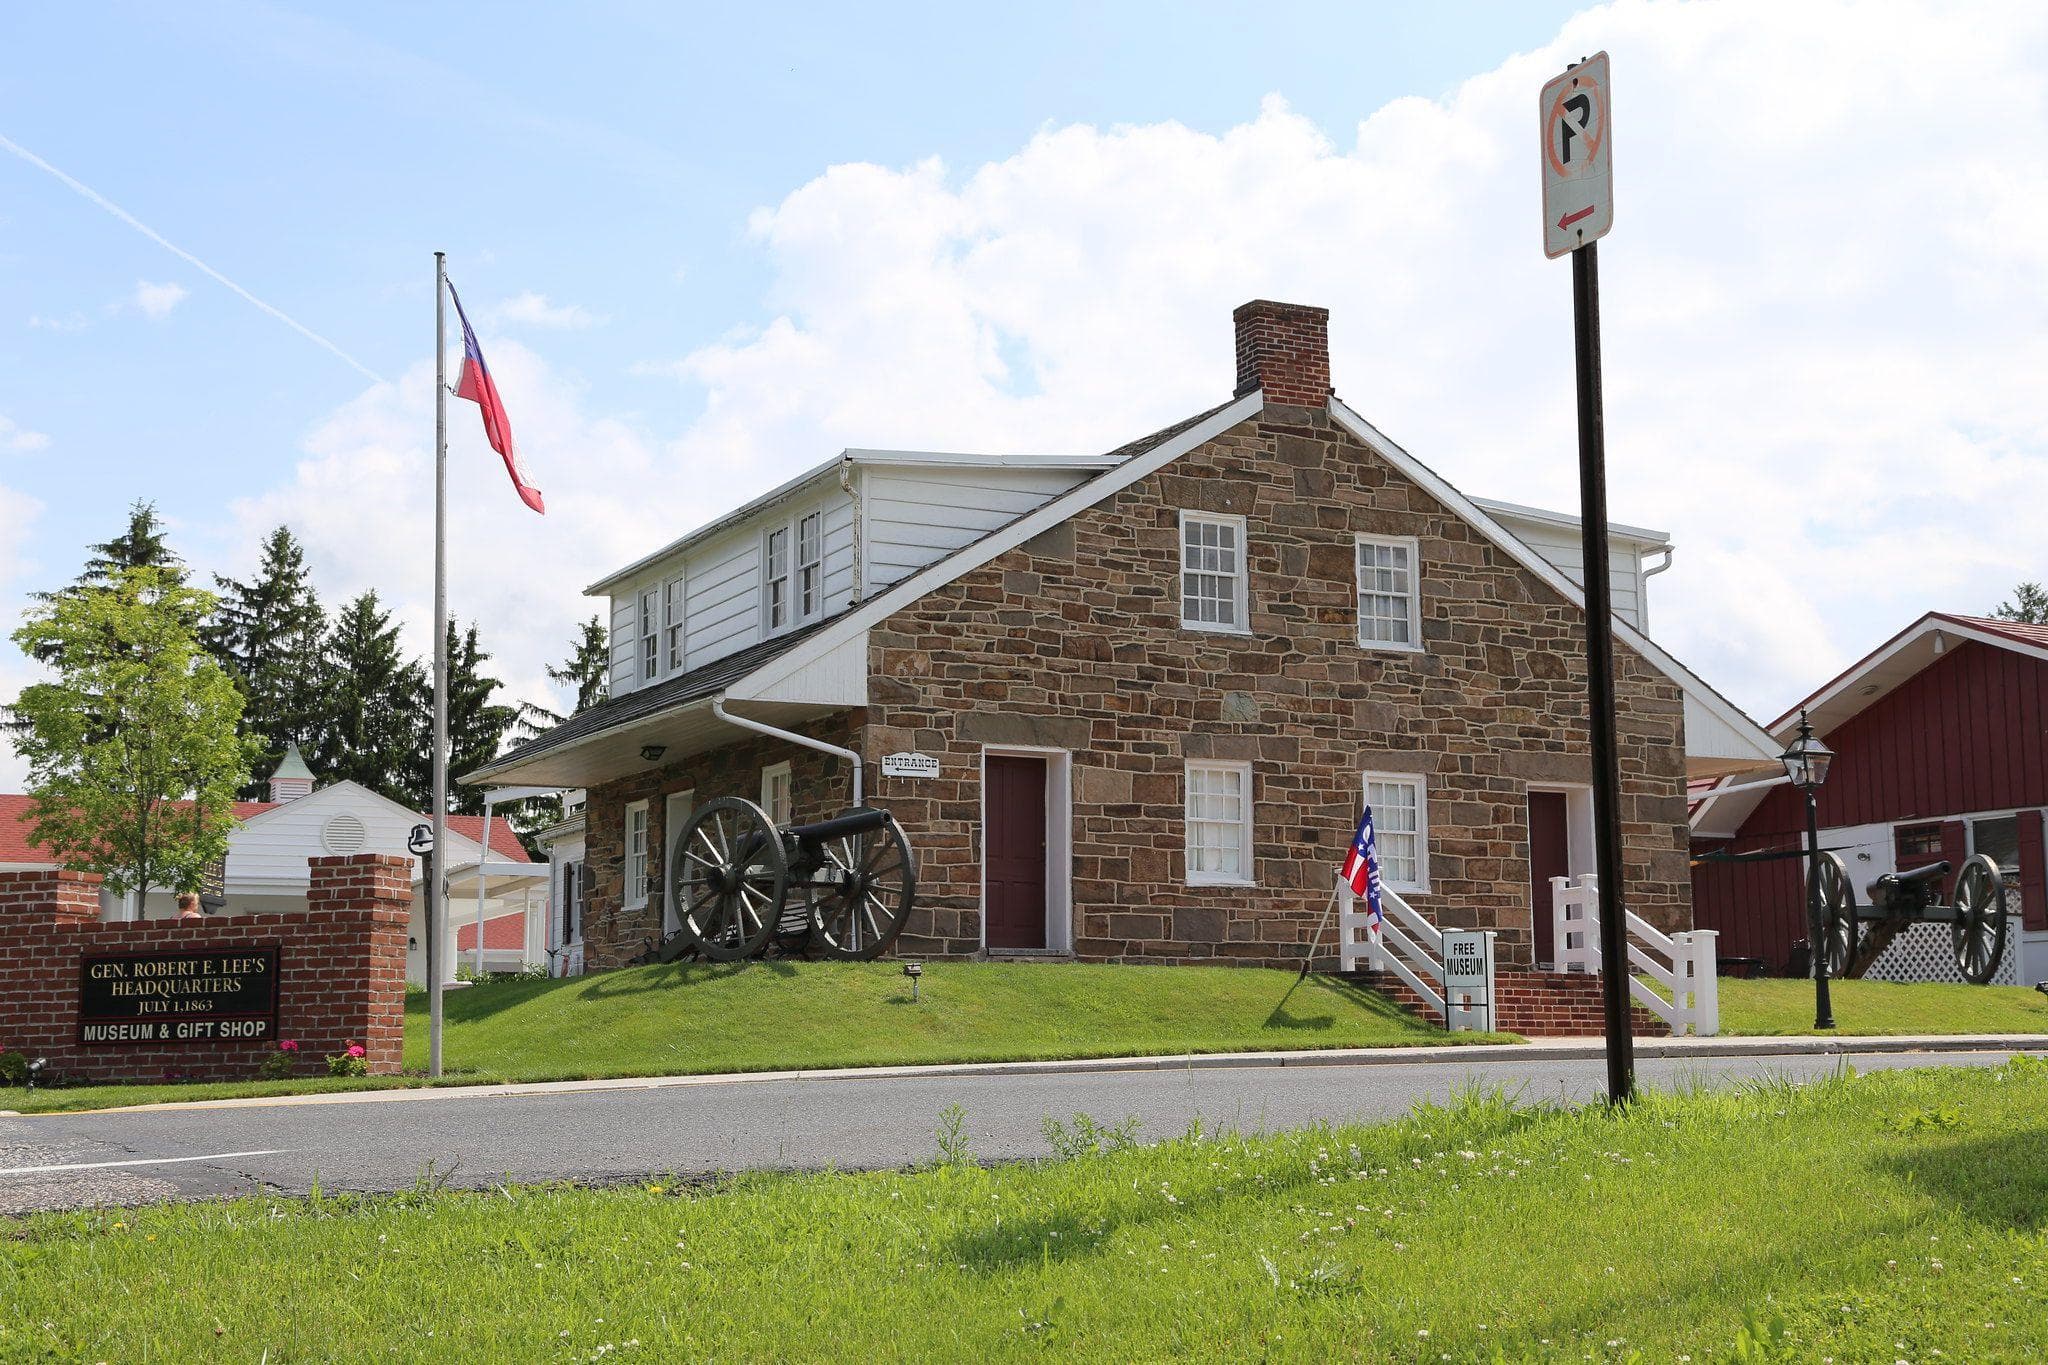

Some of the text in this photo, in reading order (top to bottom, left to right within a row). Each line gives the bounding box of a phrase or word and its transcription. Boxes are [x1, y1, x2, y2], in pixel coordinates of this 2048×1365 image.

[884, 757, 937, 768] ENTRANCE
[1453, 943, 1475, 956] FREE
[91, 958, 265, 979] GEN. ROBERT E. LEE'S
[1447, 958, 1484, 976] MUSEUM
[111, 978, 242, 998] HEADQUARTERS
[137, 1001, 170, 1016] JULY
[84, 1021, 266, 1041] MUSEUM & GIFT SHOP
